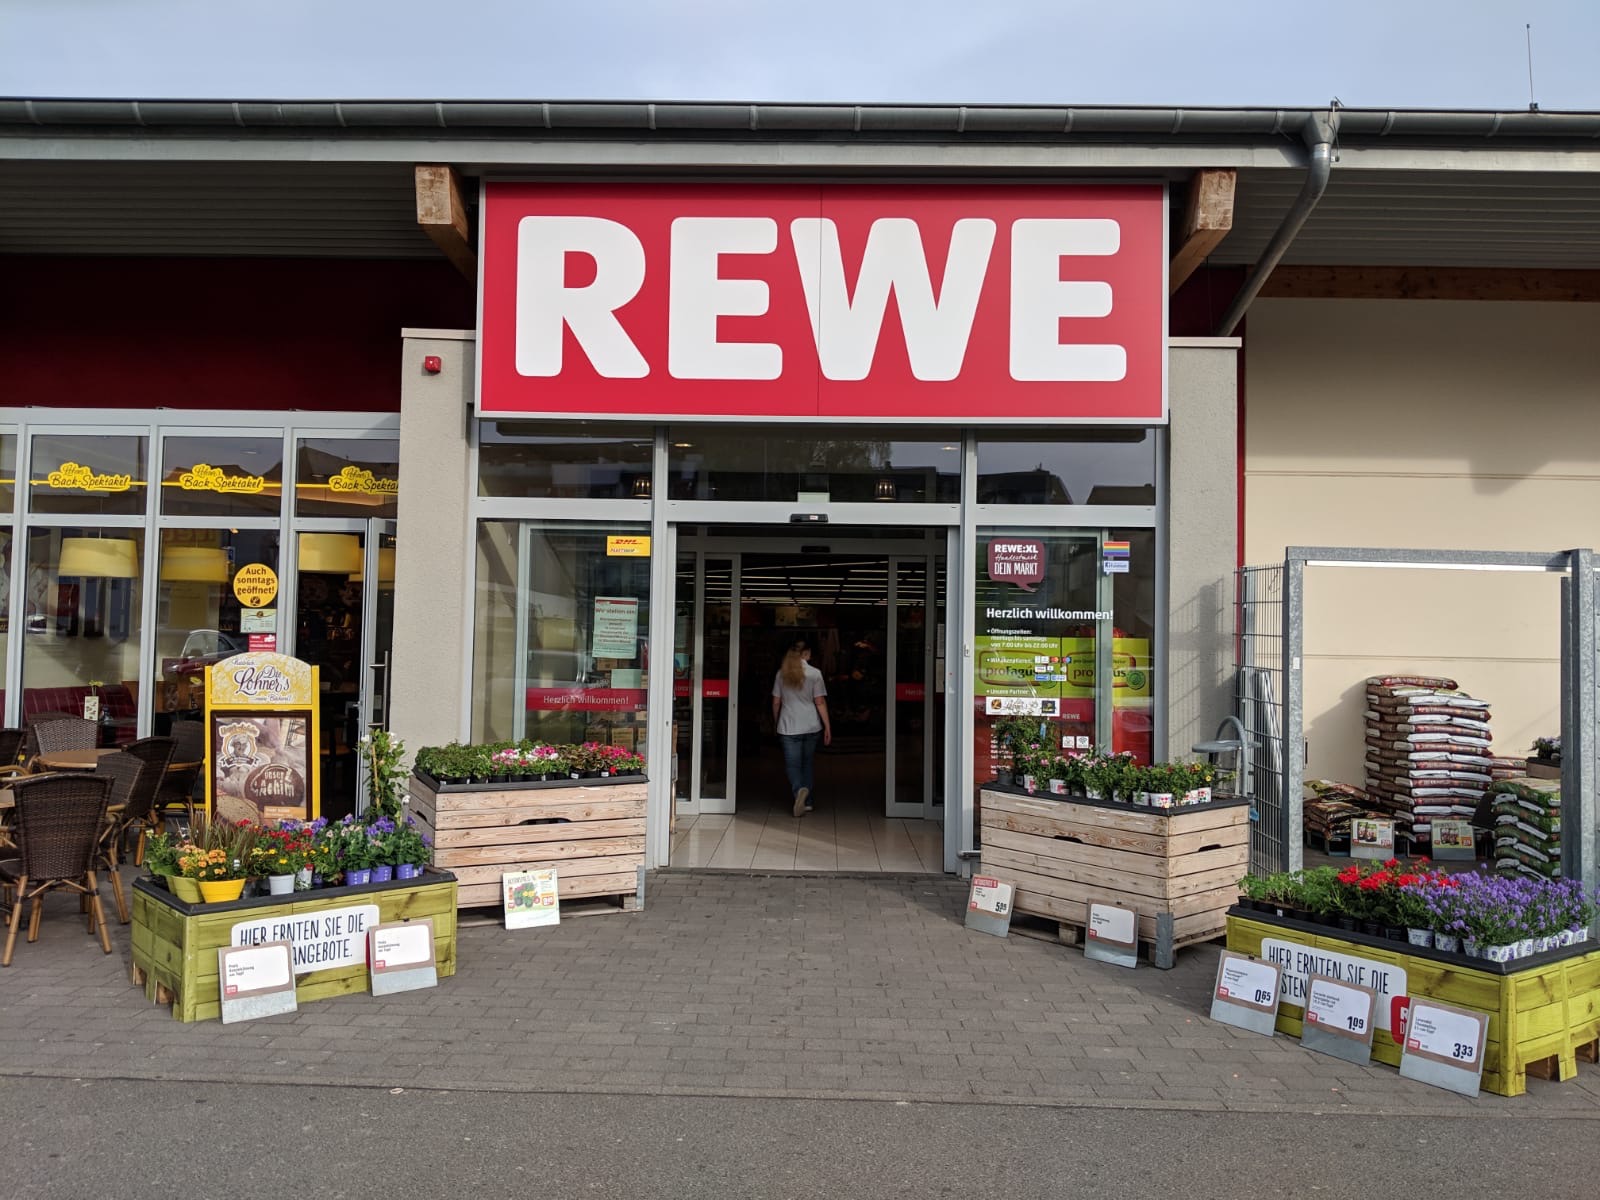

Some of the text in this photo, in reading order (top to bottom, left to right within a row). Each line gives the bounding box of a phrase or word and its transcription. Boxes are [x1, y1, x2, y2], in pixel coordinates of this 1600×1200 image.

[515, 215, 1127, 382] REWE
[50, 473, 128, 489] Back-Spektakel
[183, 475, 262, 490] Back-Spektakel
[331, 478, 398, 492] Back-Spekta
[994, 544, 1039, 553] REWE:XL
[994, 562, 1038, 576] DEIN MARKT
[237, 577, 275, 586] sonntags
[237, 586, 275, 595] geöffnet!
[986, 607, 1113, 620] Herzlich willkommen!
[990, 628, 1032, 636] Öffnungszeiten:
[543, 695, 575, 705] Herzlich
[240, 913, 364, 946] HIER ERNTEN SIE DIE
[1268, 945, 1390, 995] HIER ERNTEN SIE DIE
[1281, 973, 1307, 998] STEN
[1254, 989, 1272, 1004] 0.65
[1346, 1015, 1365, 1031] 1.09
[1452, 1042, 1474, 1060] 3.33
